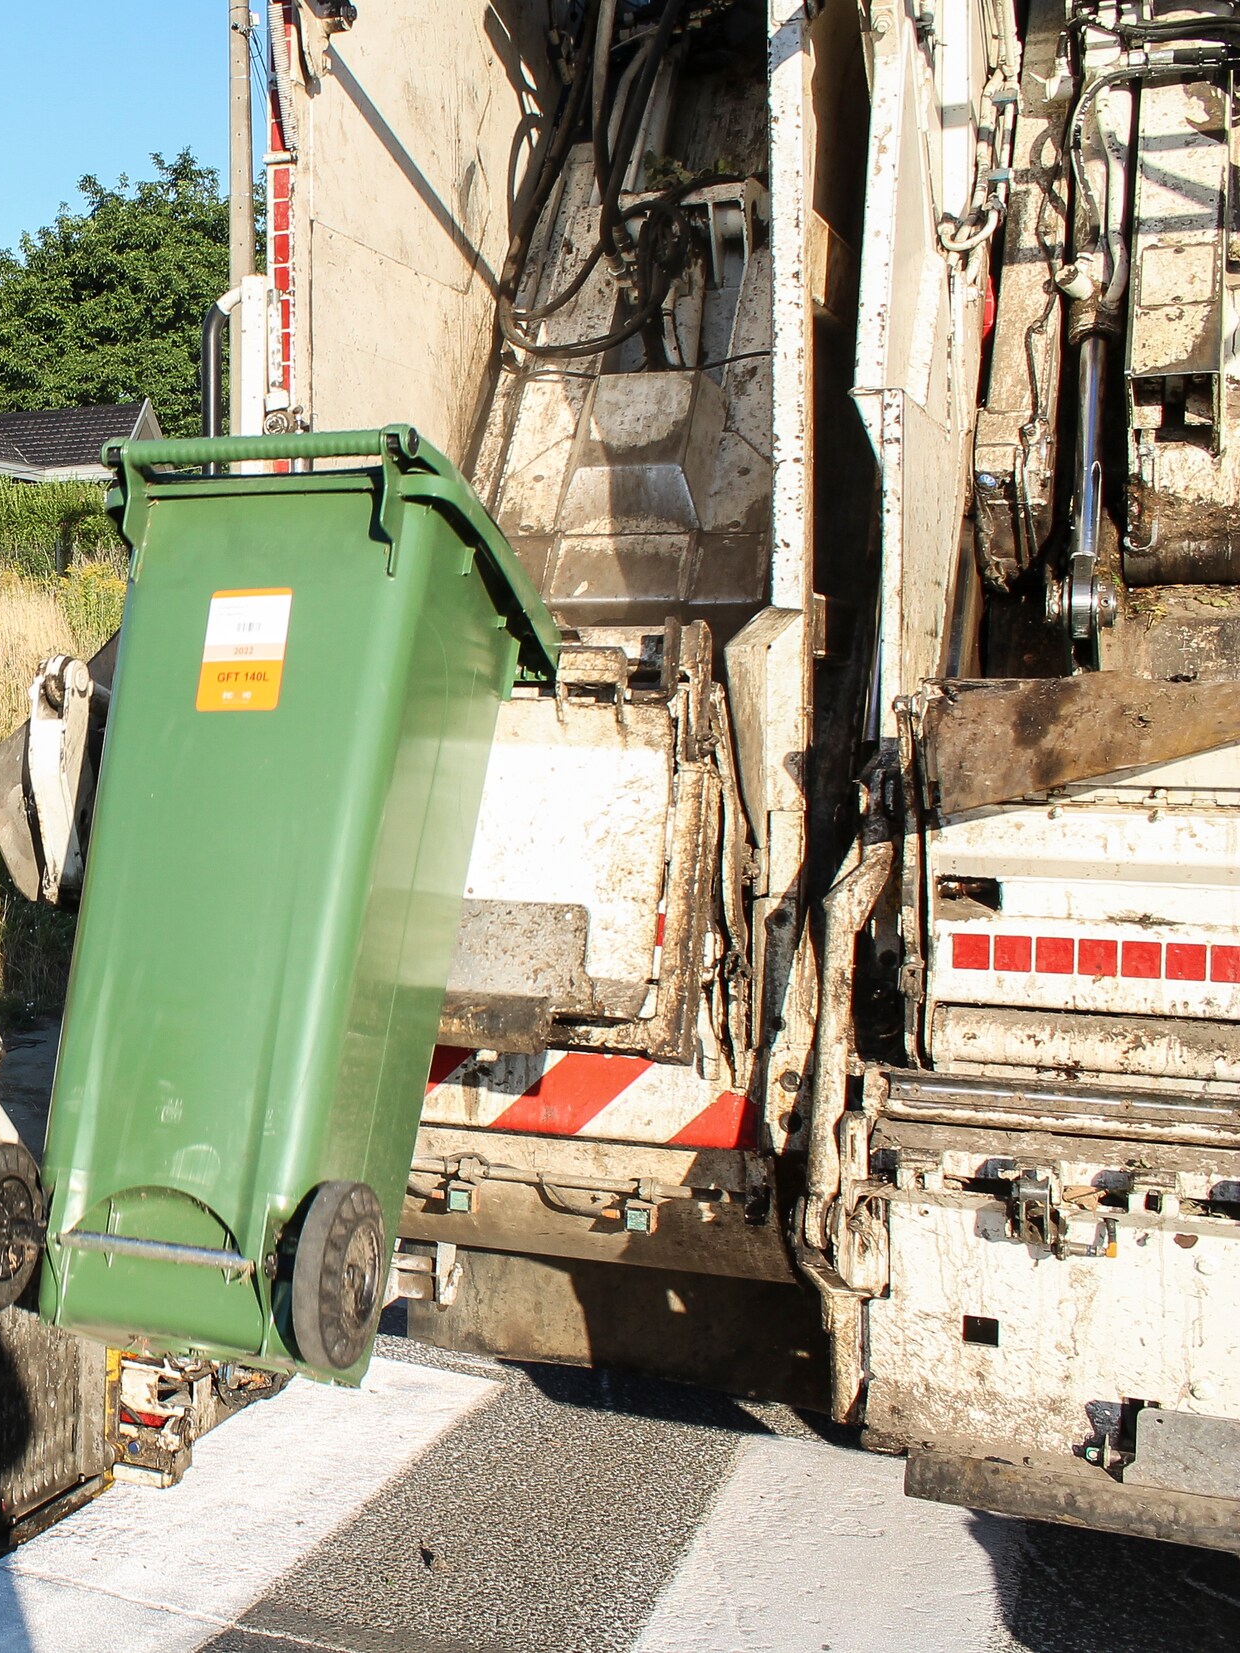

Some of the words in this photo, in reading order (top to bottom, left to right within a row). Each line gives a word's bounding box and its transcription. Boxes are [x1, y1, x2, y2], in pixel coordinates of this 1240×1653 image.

[233, 647, 254, 656] 2022
[217, 672, 240, 683] GFT
[243, 671, 269, 682] 140L
